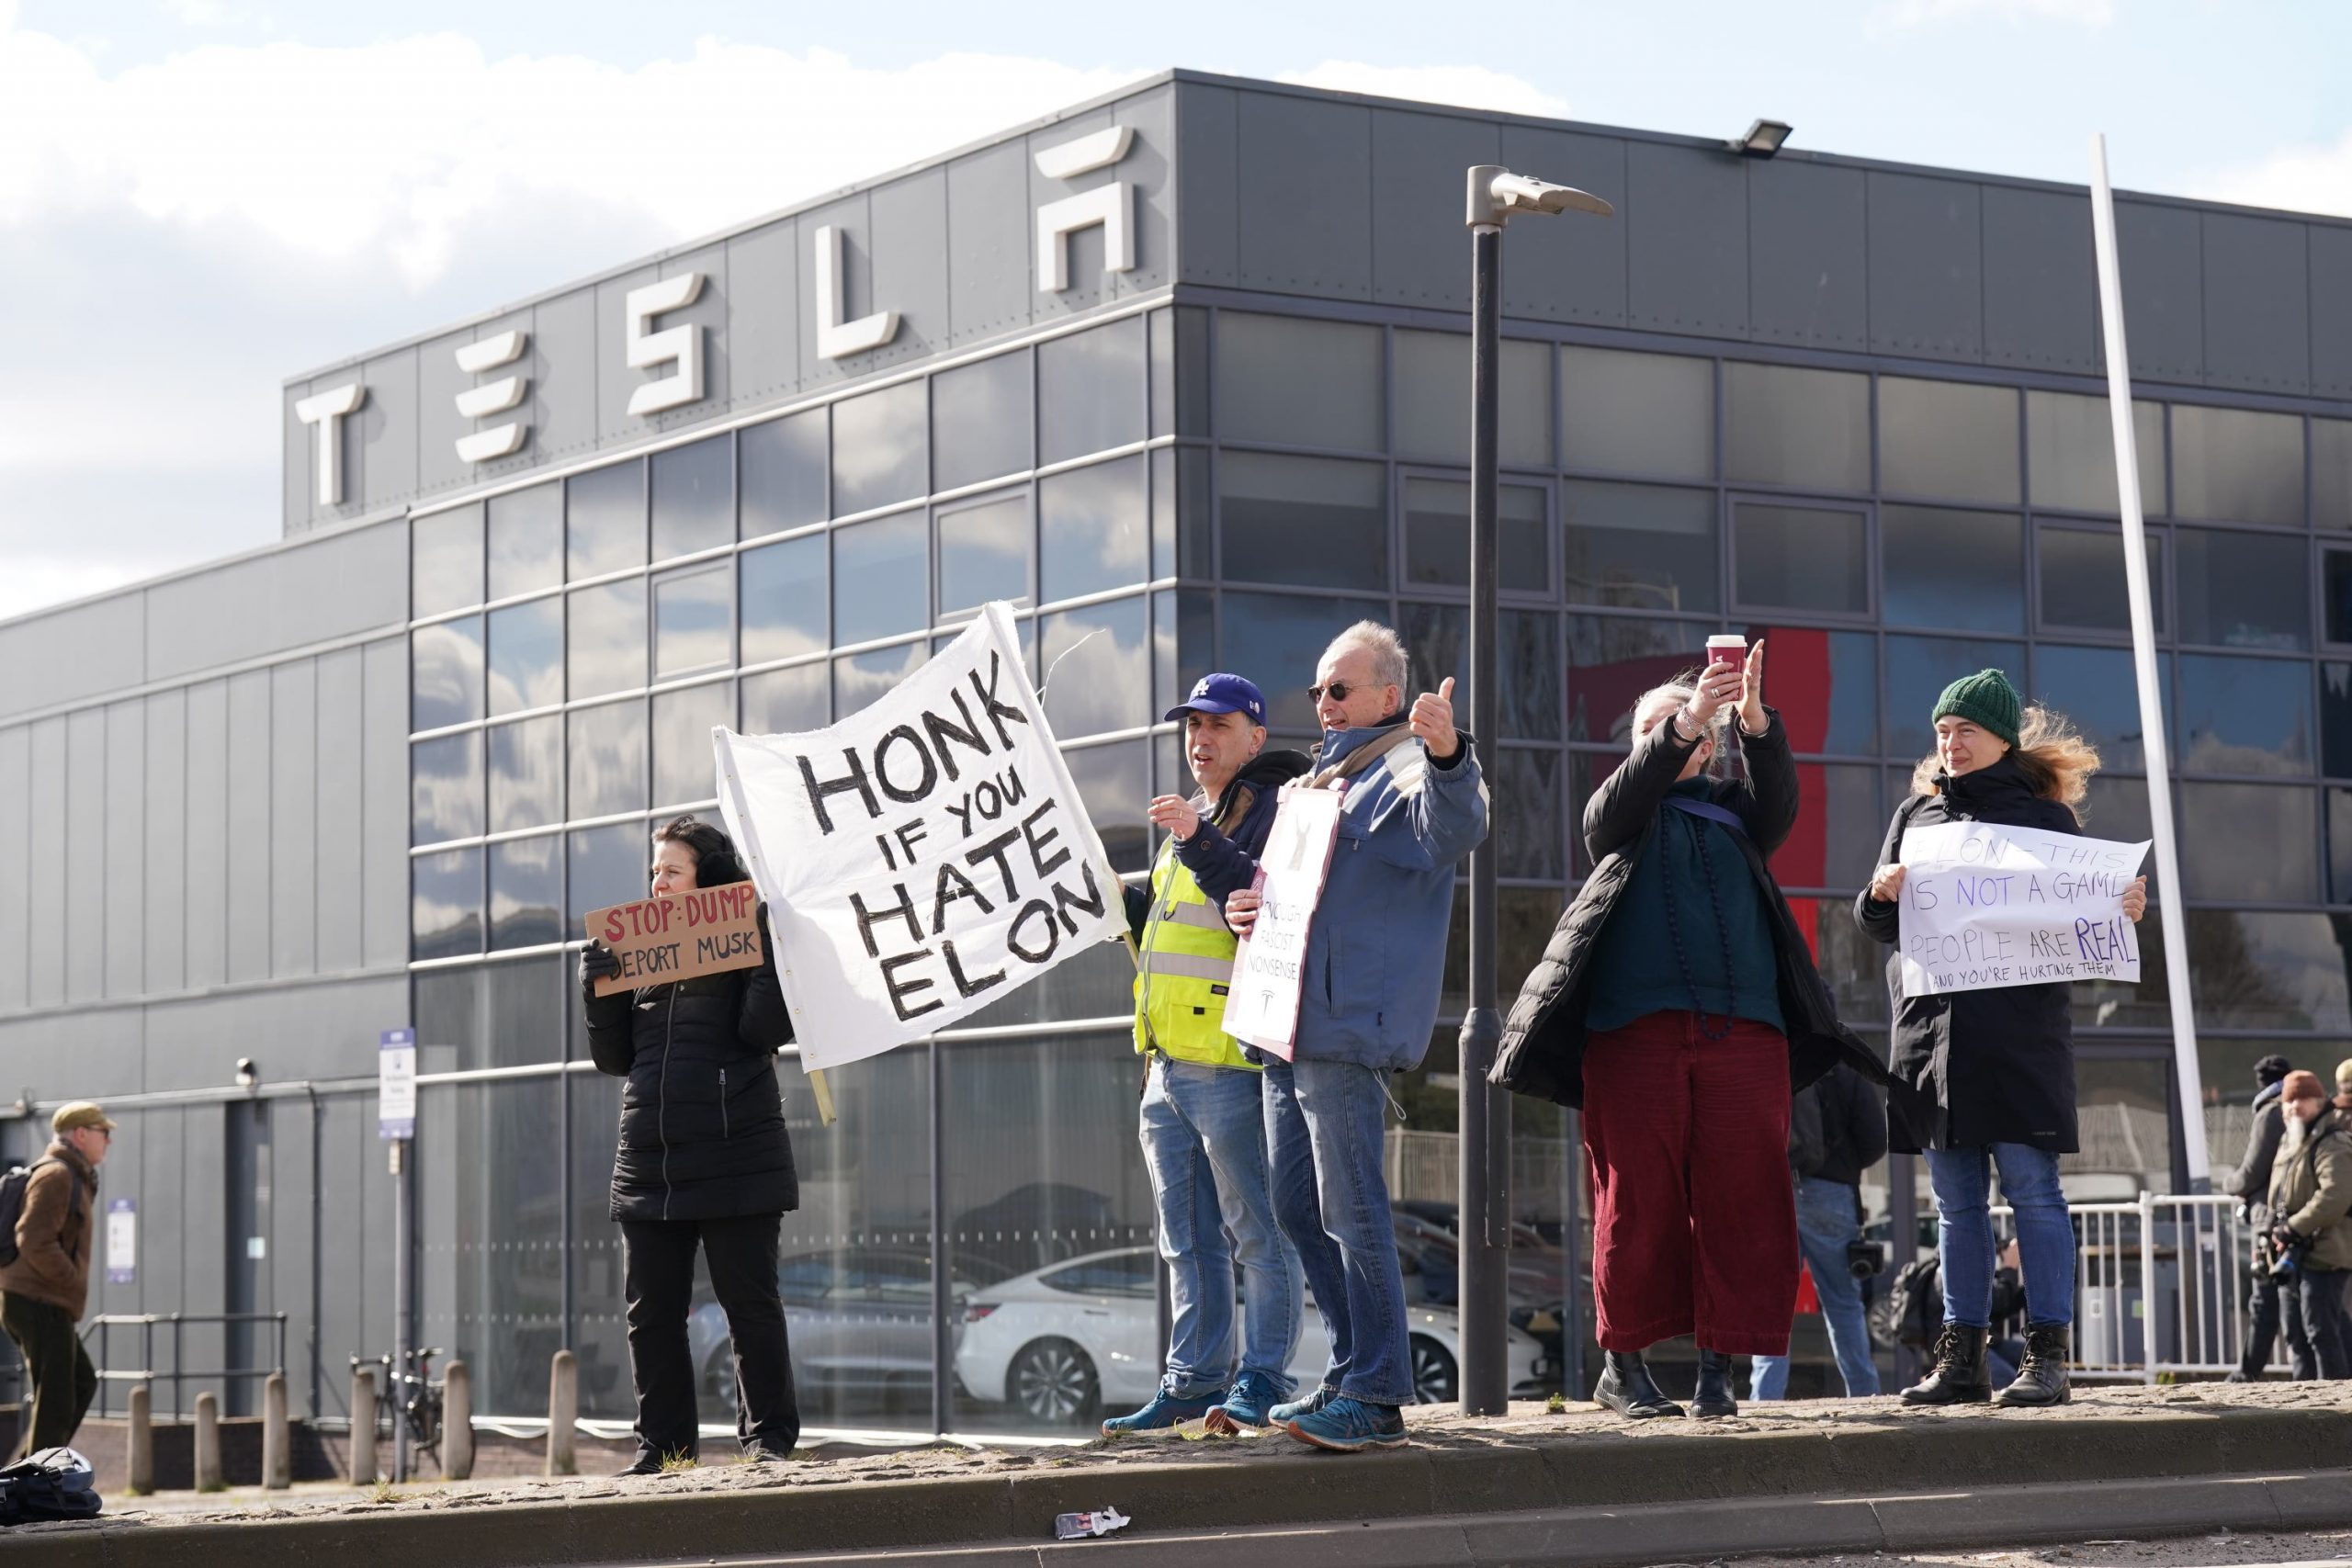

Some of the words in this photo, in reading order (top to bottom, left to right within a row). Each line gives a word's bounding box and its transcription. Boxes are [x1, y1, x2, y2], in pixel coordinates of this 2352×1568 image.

[295, 124, 1136, 506] TESLA
[796, 649, 1029, 836] HONK
[876, 818, 929, 871] IF
[945, 763, 1027, 838] YOU
[849, 797, 1072, 958] HATE
[2041, 842, 2130, 868] THIS
[1909, 879, 1939, 910] IS
[1957, 875, 2015, 907] NOT
[2029, 874, 2046, 904] A
[2052, 869, 2132, 905] GAME
[697, 931, 757, 964] MUSK
[879, 858, 1106, 1022] ELON
[1910, 929, 2014, 967] PEOPLE
[2030, 930, 2072, 960] ARE
[2075, 915, 2138, 964] REAL
[1249, 955, 1297, 981] NONSENSE
[1933, 975, 1954, 988] AND
[1959, 966, 2009, 984] YOU'RE
[2020, 964, 2075, 981] HURTING
[2079, 961, 2116, 977] THEM
